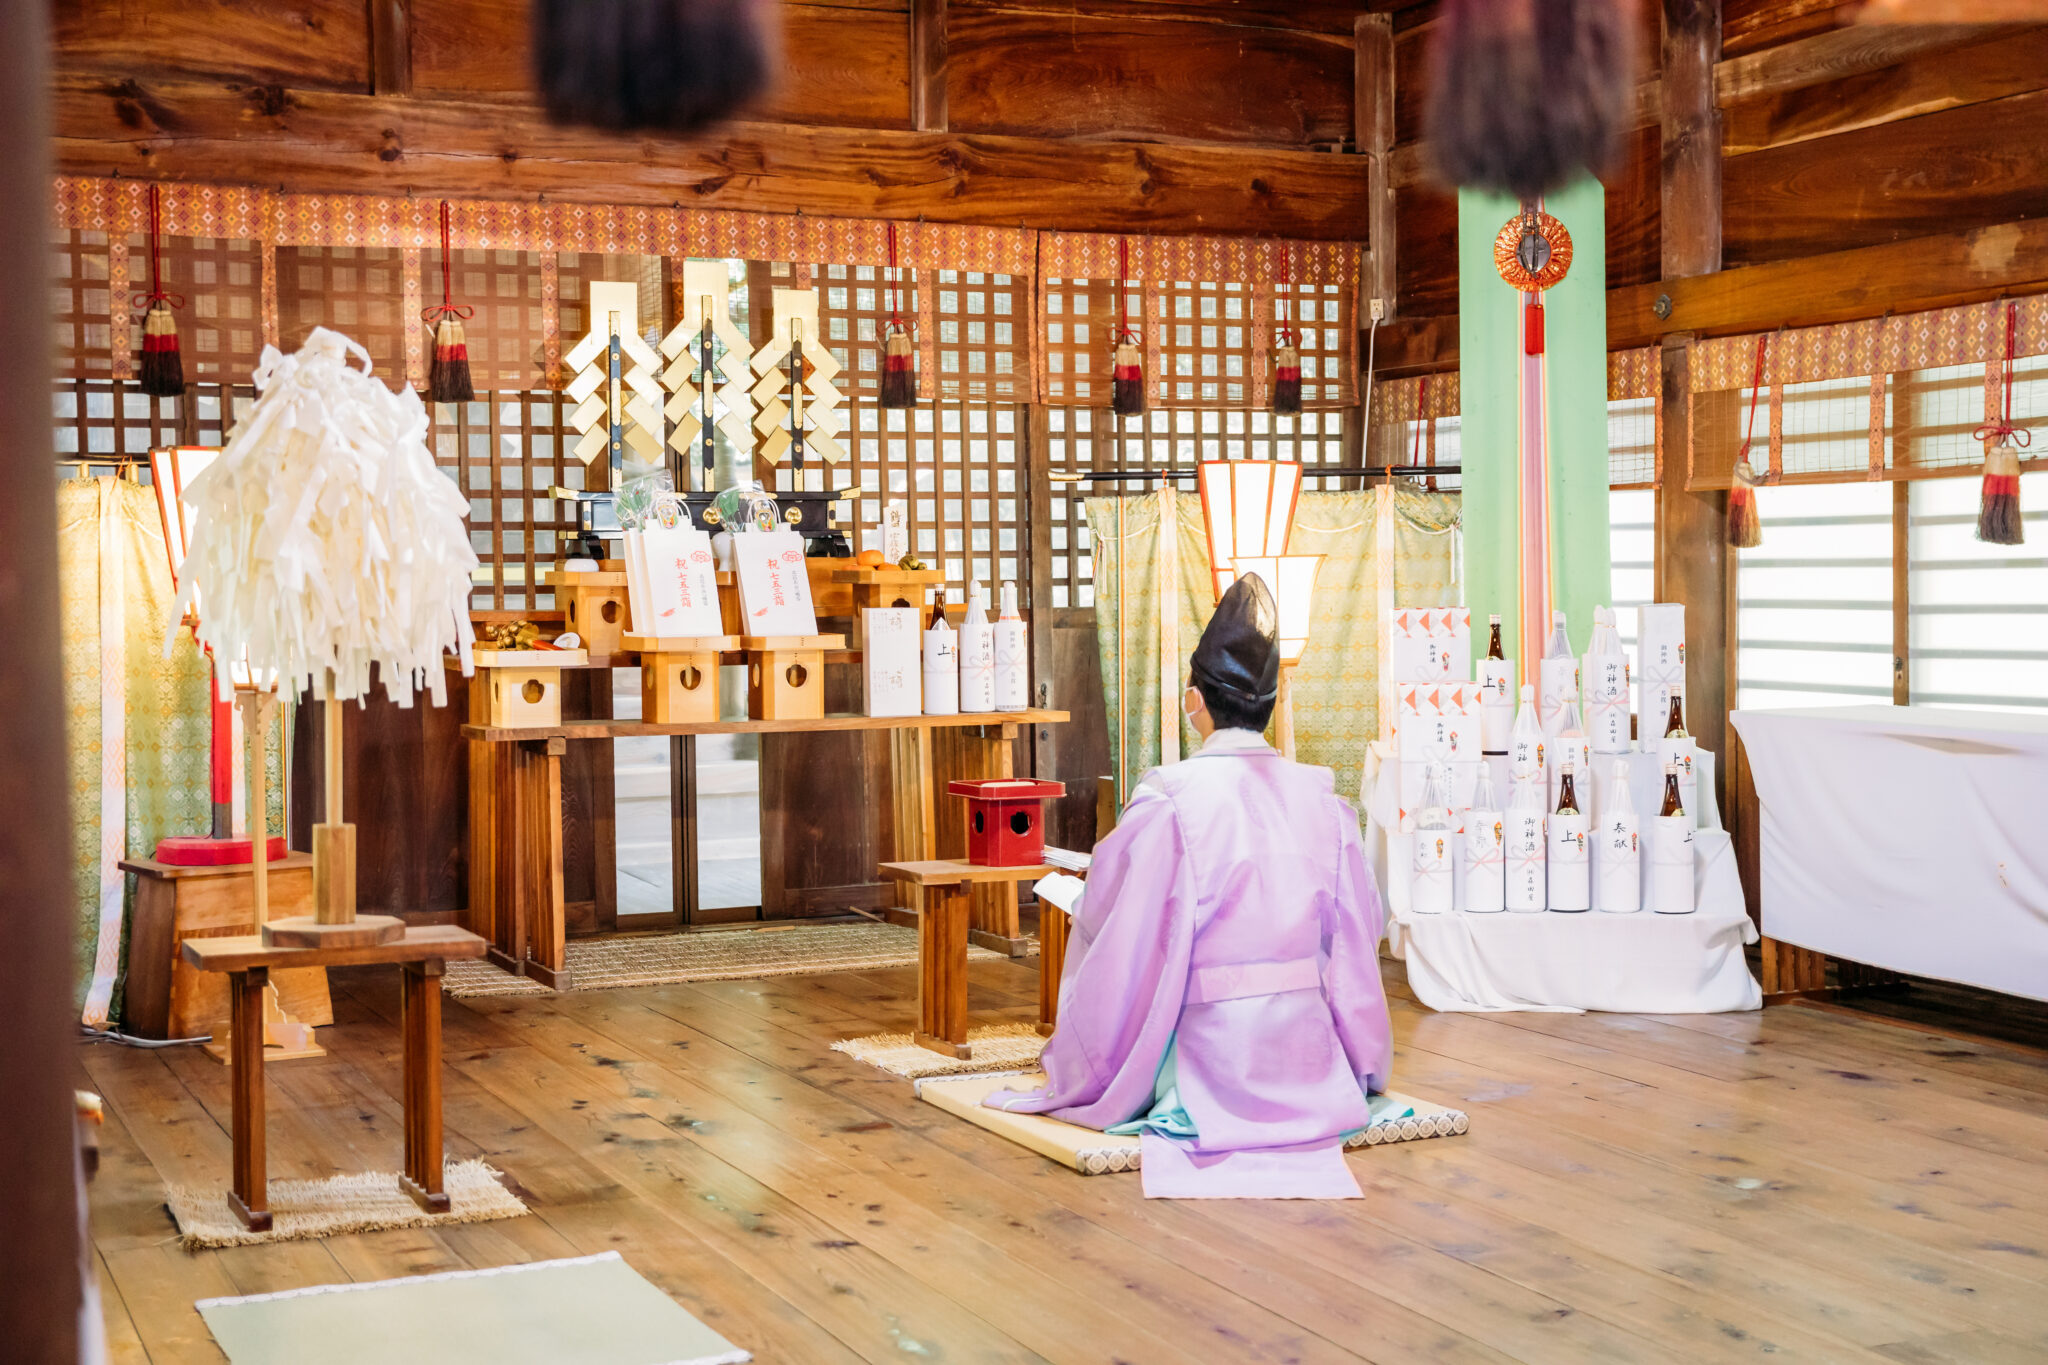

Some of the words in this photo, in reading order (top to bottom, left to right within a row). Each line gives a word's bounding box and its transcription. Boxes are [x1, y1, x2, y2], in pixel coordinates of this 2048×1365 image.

[937, 643, 951, 656] 上
[1482, 674, 1496, 688] 上
[1606, 663, 1618, 696] 御神酒
[1524, 817, 1536, 852] 御神酒
[1560, 830, 1577, 842] 上
